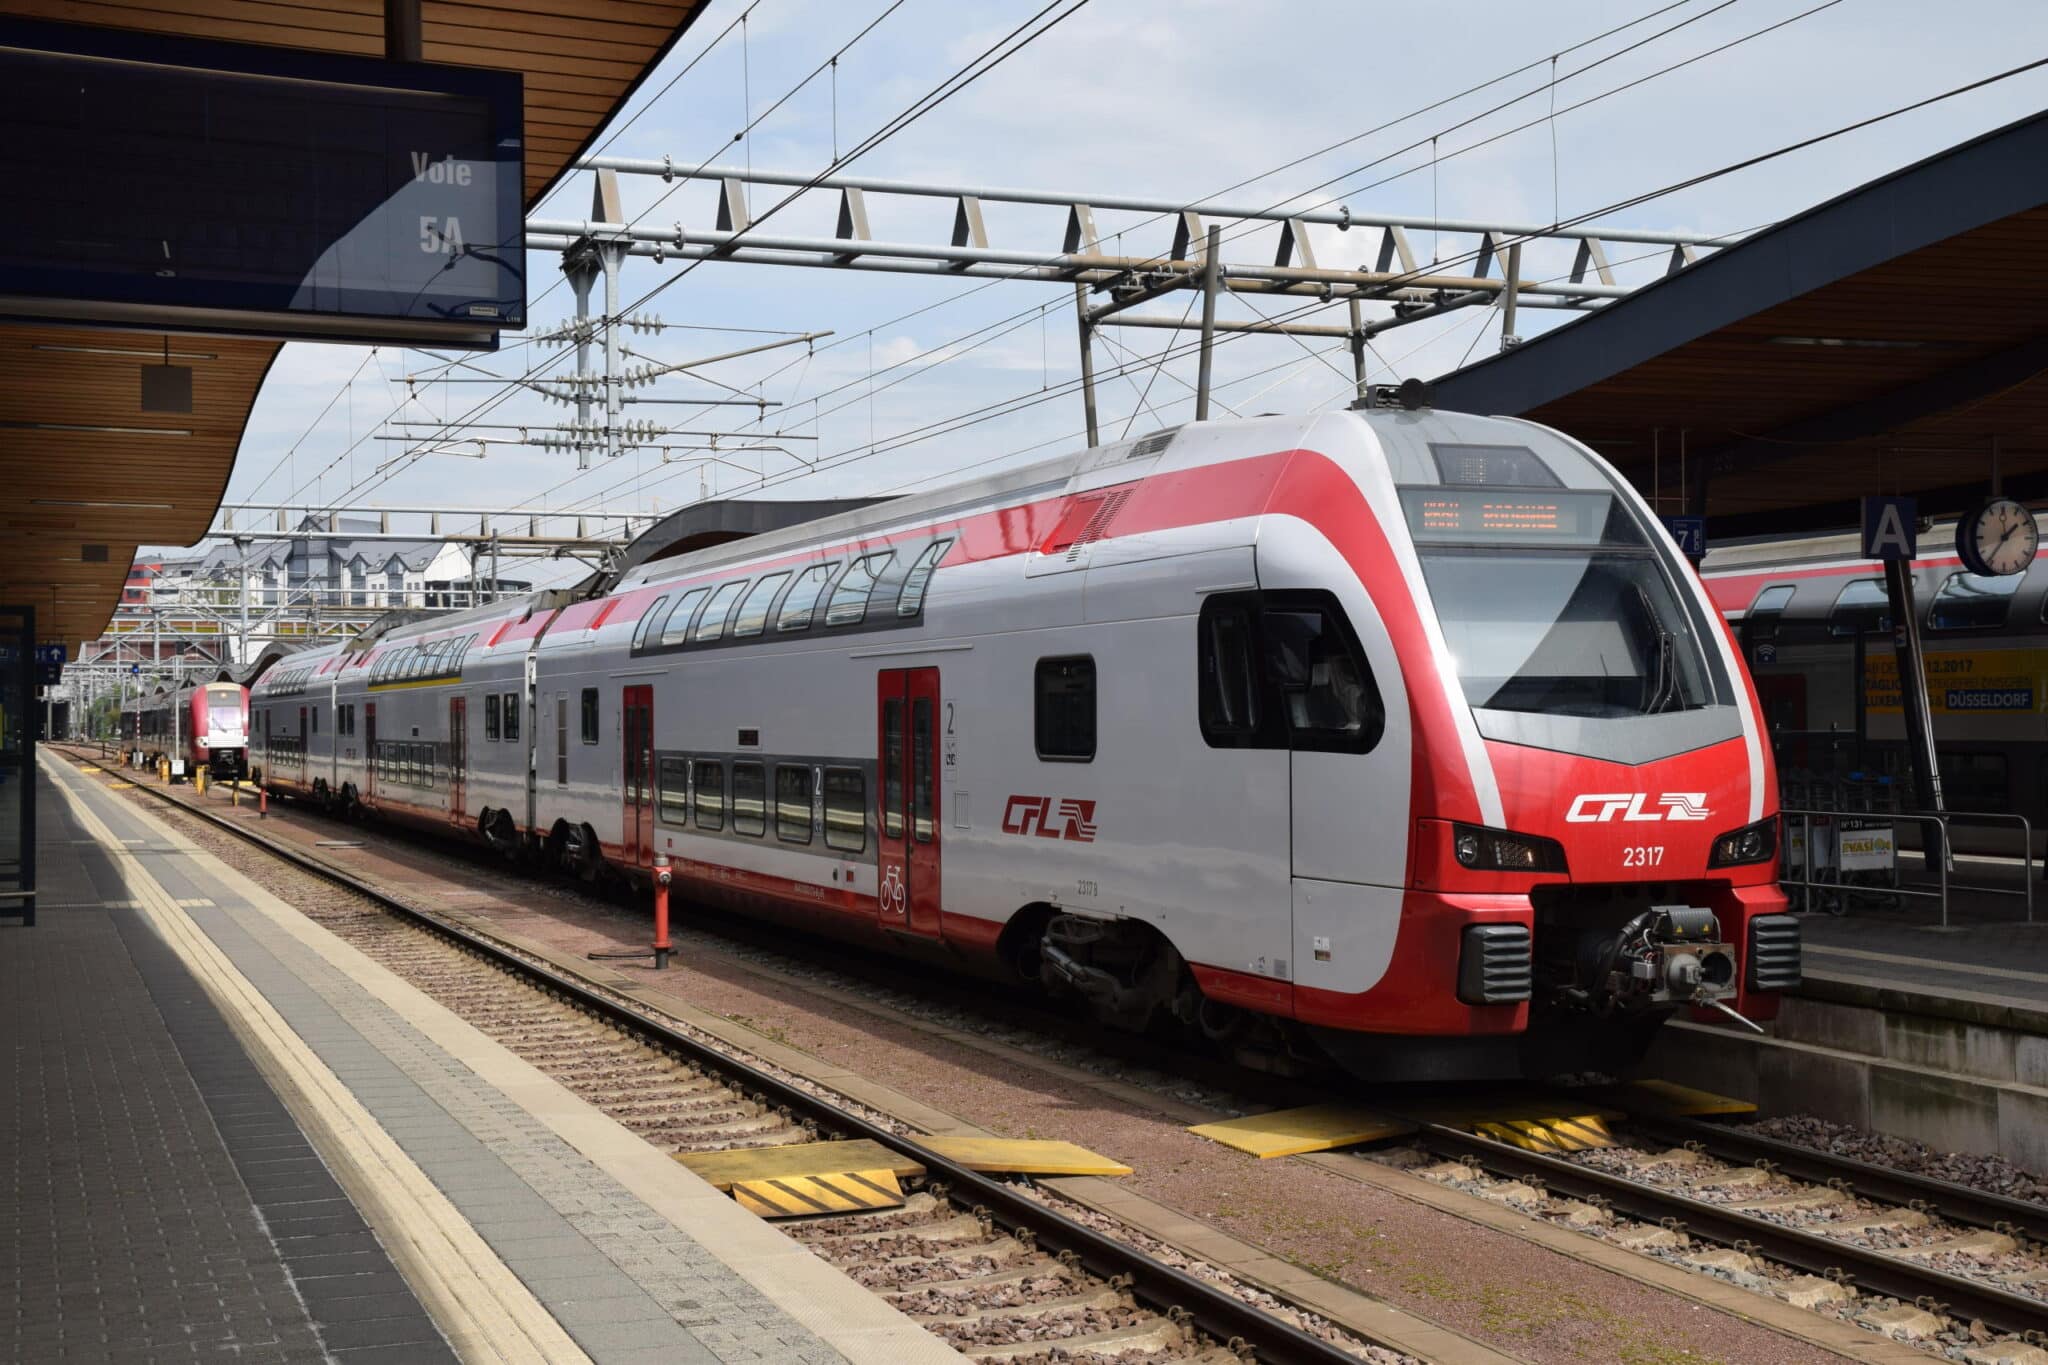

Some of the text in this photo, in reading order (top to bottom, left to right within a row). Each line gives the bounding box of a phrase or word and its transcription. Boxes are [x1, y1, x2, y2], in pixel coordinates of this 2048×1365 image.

[411, 151, 472, 186] Voie
[420, 216, 465, 255] 5A
[1677, 530, 1689, 550] 7
[1870, 503, 1911, 555] A
[1948, 690, 2029, 708] DÜSSELDORF
[947, 703, 955, 735] 2
[815, 767, 821, 796] 2
[1002, 795, 1060, 838] CFL
[1565, 793, 1663, 822] CFL
[1623, 846, 1664, 867] 2317
